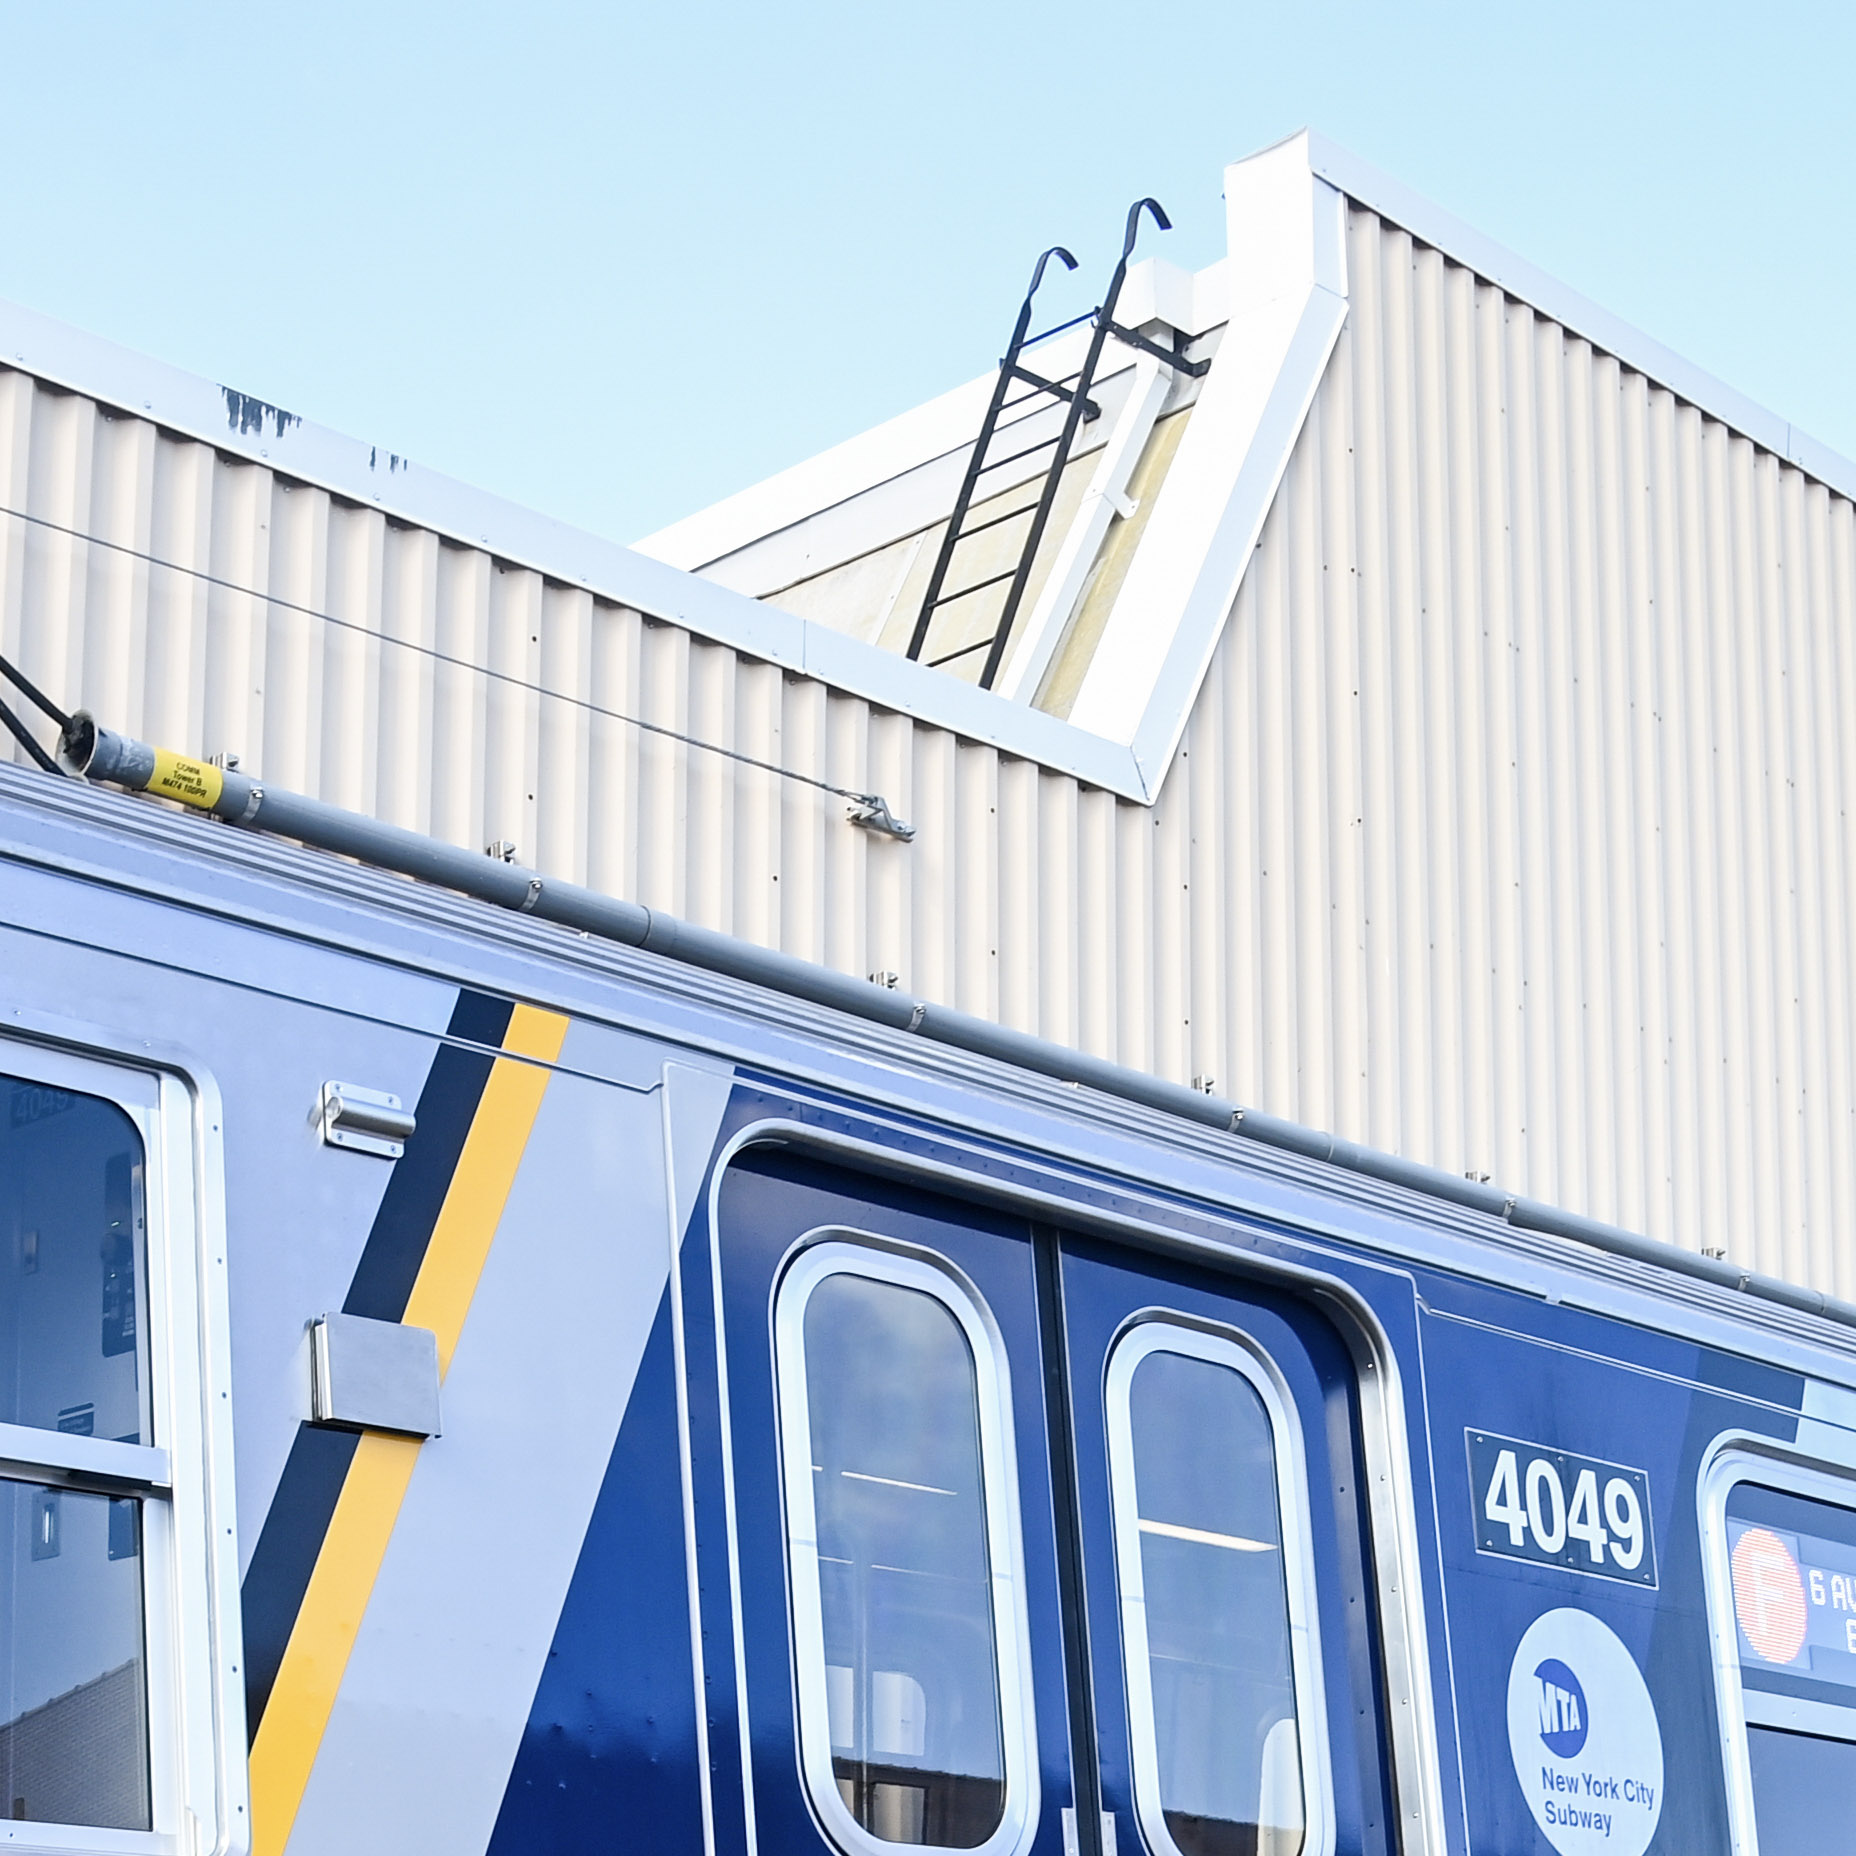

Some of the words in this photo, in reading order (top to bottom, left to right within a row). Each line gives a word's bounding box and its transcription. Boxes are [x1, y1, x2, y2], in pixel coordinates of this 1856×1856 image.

[172, 770, 195, 784] Tower
[196, 777, 203, 786] B
[1485, 1449, 1644, 1571] 4049
[1751, 1549, 1787, 1637] F
[1808, 1569, 1826, 1606] 6
[1538, 1677, 1582, 1735] MTA
[1542, 1766, 1578, 1794] New
[1581, 1772, 1620, 1801] York
[1623, 1778, 1655, 1811] City
[1544, 1800, 1612, 1838] Subway
